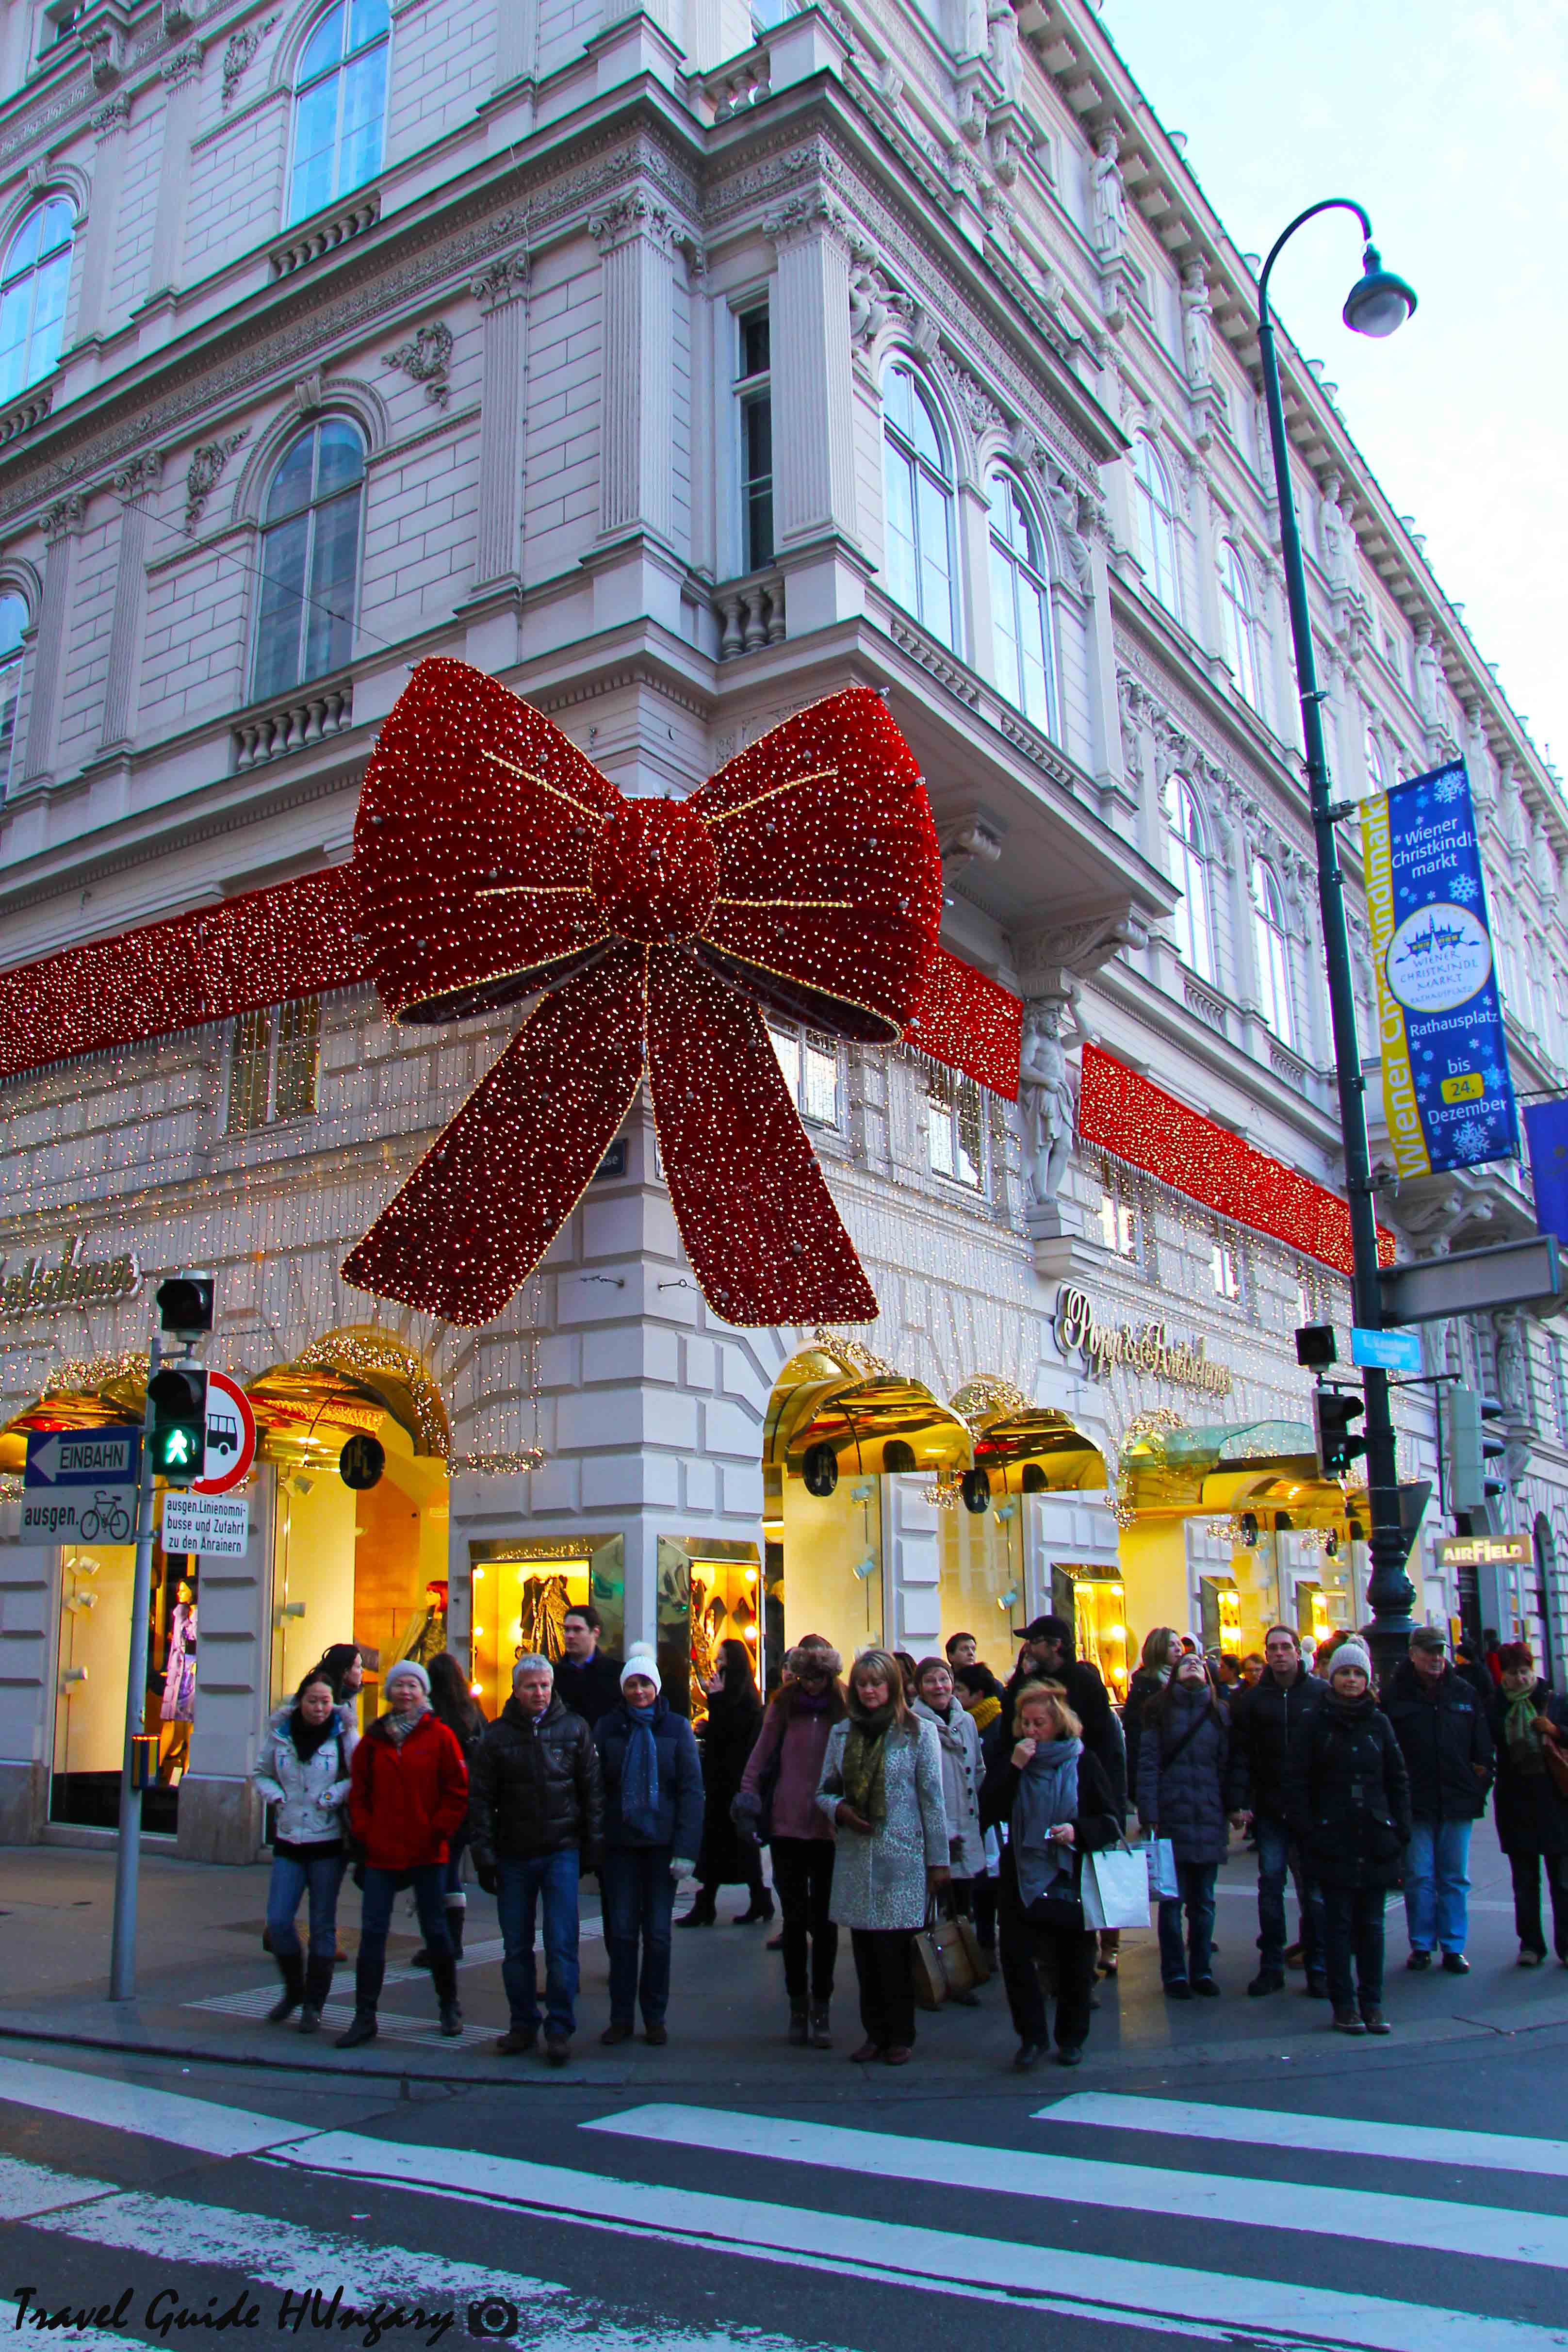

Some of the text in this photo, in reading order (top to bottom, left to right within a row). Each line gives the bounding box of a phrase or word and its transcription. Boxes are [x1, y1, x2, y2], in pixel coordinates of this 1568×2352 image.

[1405, 818, 1458, 846] Wiener
[1392, 830, 1479, 868] Christkindl-
[1412, 853, 1458, 879] markt
[1401, 959, 1478, 982] CHRISTKINDL
[1412, 950, 1461, 967] WIENER
[1360, 792, 1427, 1179] Wiener Chrtkindlmarkt
[1417, 973, 1462, 991] MARKT
[1409, 1010, 1499, 1037] Rathausplatz
[1447, 1057, 1470, 1074] bis
[1451, 1080, 1475, 1096] 24.
[1427, 1098, 1507, 1125] Dezember
[60, 1443, 125, 1470] EINBAHN
[25, 1505, 79, 1532] ausgen.
[167, 1515, 244, 1535] busse und Zufahrt
[168, 1535, 241, 1552] zu den Anrainern
